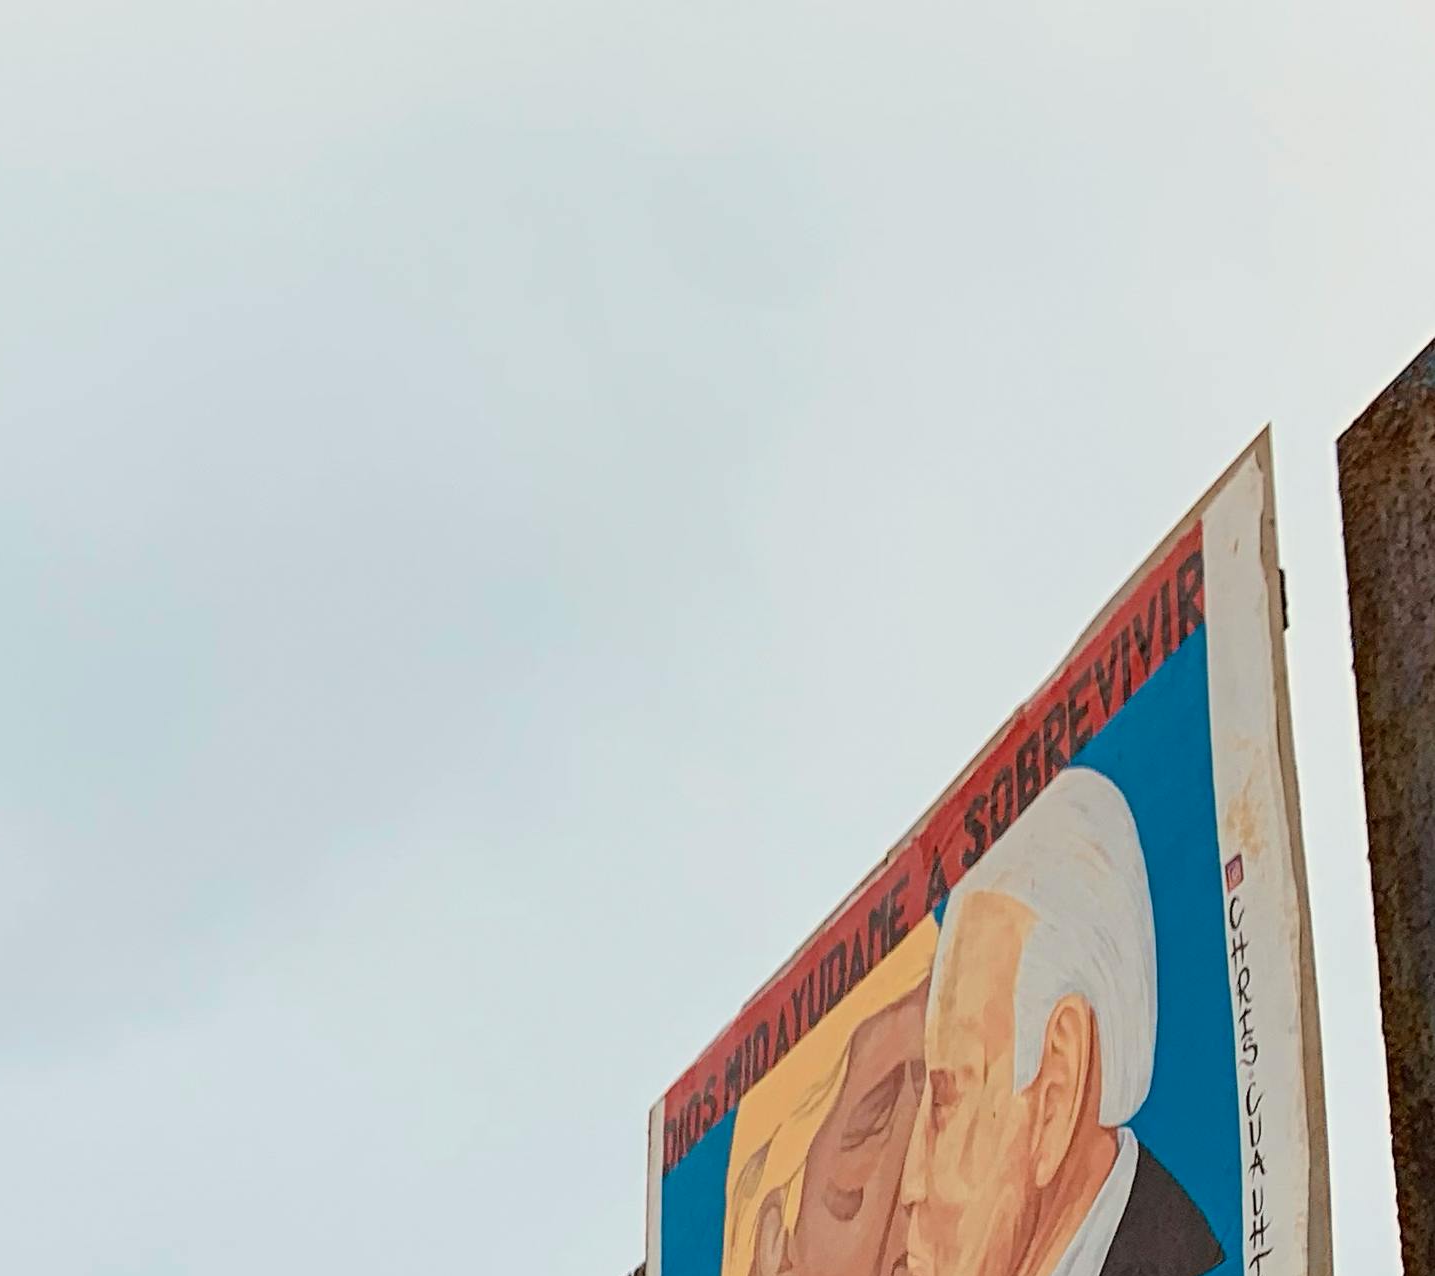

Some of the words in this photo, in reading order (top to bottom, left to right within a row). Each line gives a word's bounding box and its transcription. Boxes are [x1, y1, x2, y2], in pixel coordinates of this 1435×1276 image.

[661, 1072, 718, 1179] DIOS
[926, 846, 951, 915] A
[962, 548, 1206, 872] SOBREVIVIR
